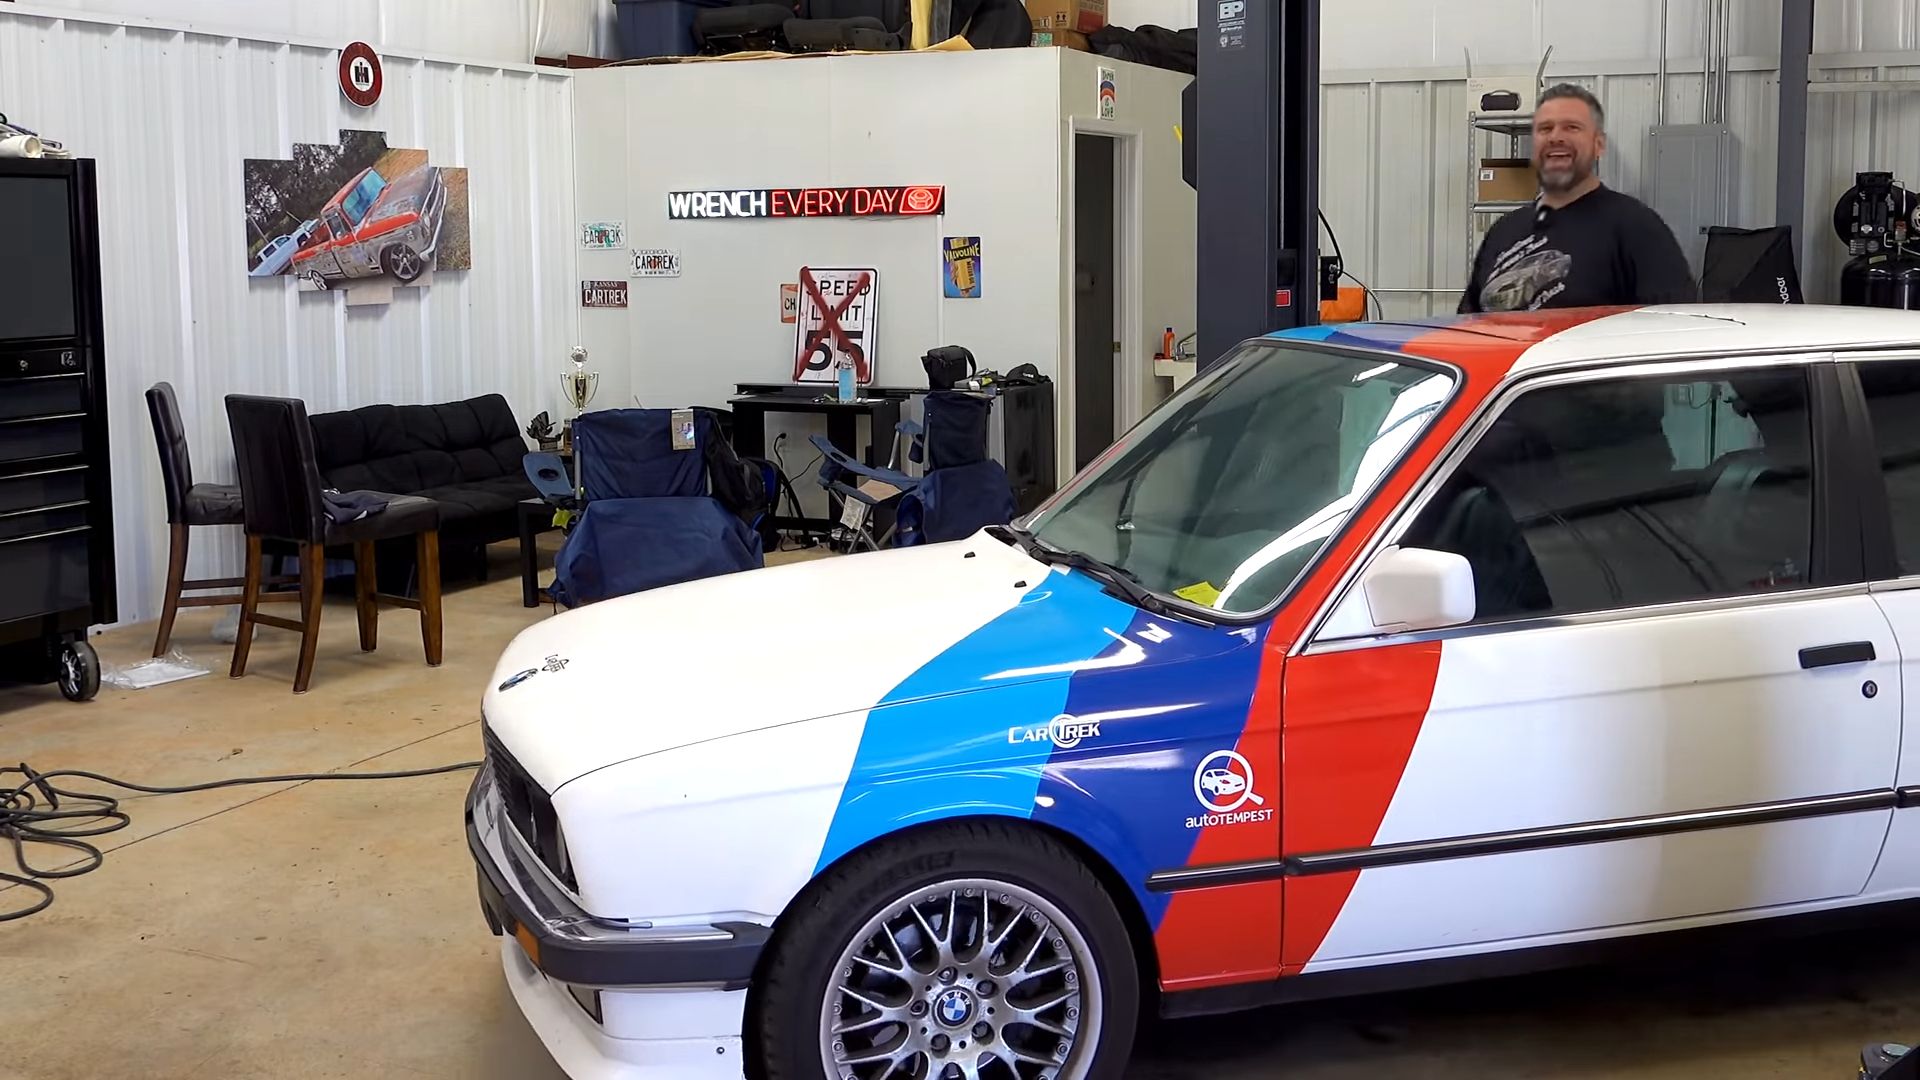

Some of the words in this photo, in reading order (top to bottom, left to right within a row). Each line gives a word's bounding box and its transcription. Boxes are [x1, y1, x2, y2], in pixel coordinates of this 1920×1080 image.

[669, 191, 766, 218] WRENCH
[772, 188, 849, 216] EVERY
[855, 188, 898, 214] DAY
[943, 242, 981, 263] VALVOLINE
[635, 255, 675, 270] CARTREK
[584, 289, 627, 305] CARTREK
[811, 304, 862, 321] LIT
